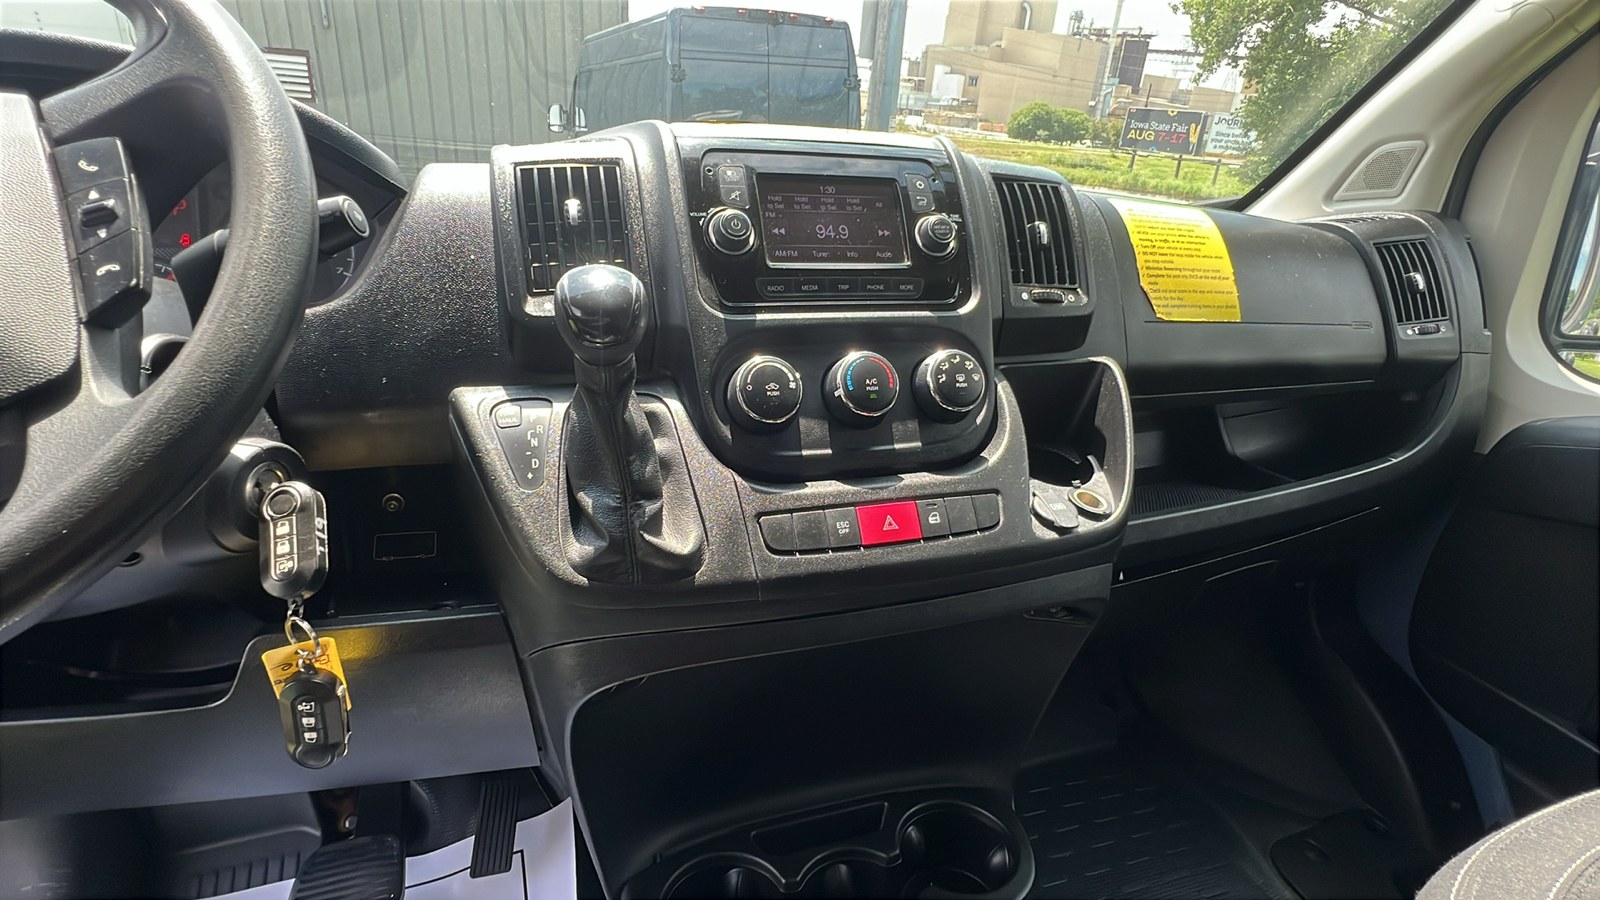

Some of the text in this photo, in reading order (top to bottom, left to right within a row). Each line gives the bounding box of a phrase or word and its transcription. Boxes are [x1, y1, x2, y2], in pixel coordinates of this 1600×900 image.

[1130, 120, 1188, 132] Iowa State Fair
[1127, 129, 1187, 144] AUG 7-17
[816, 224, 849, 239] 94.9
[536, 425, 543, 434] R
[530, 438, 538, 447] N
[532, 458, 539, 468] D
